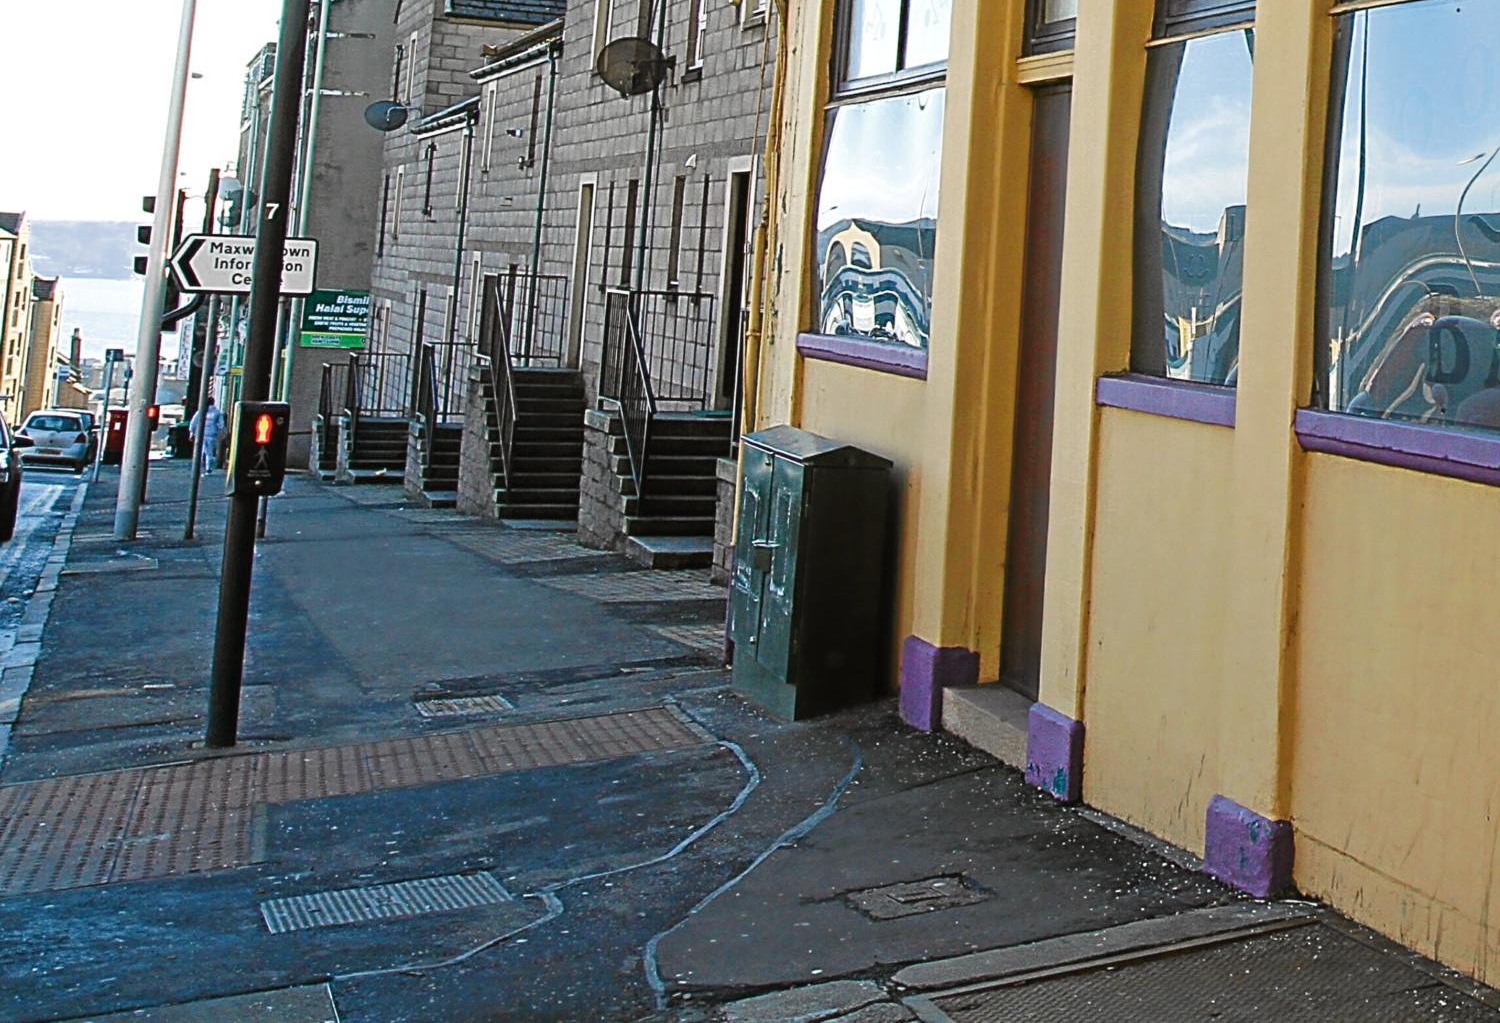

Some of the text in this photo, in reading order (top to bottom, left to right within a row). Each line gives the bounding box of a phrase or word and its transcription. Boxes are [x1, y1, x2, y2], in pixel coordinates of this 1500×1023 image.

[266, 202, 280, 220] 7
[209, 242, 310, 257] Maxwown
[214, 257, 303, 272] Inforion
[315, 303, 345, 313] Halal
